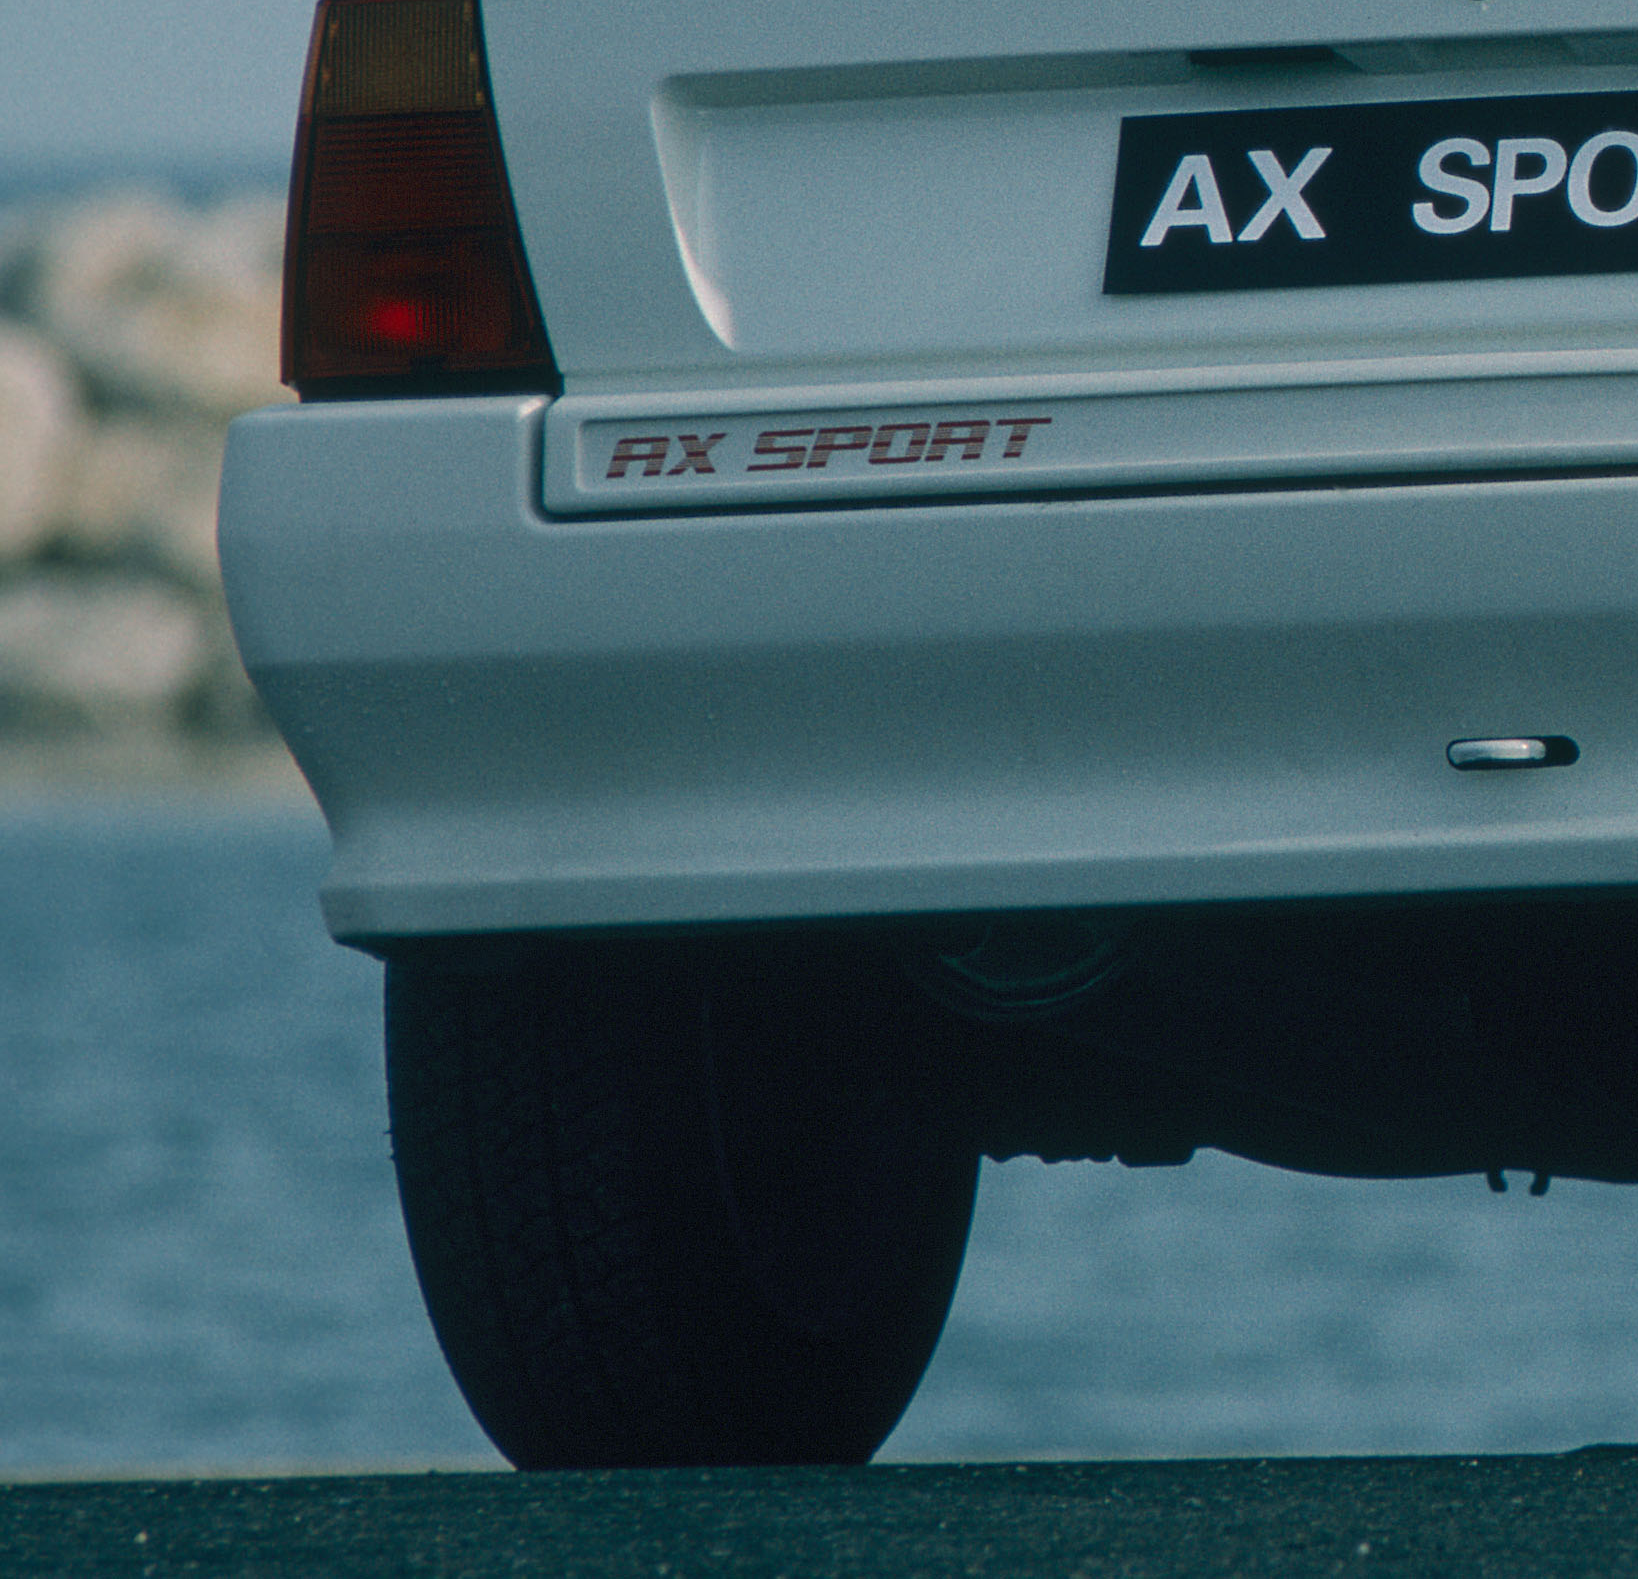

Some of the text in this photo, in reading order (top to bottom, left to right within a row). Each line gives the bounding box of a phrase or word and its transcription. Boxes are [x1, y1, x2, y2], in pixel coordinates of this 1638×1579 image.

[1140, 147, 1332, 247] AX
[606, 417, 1052, 479] AX SPORT
